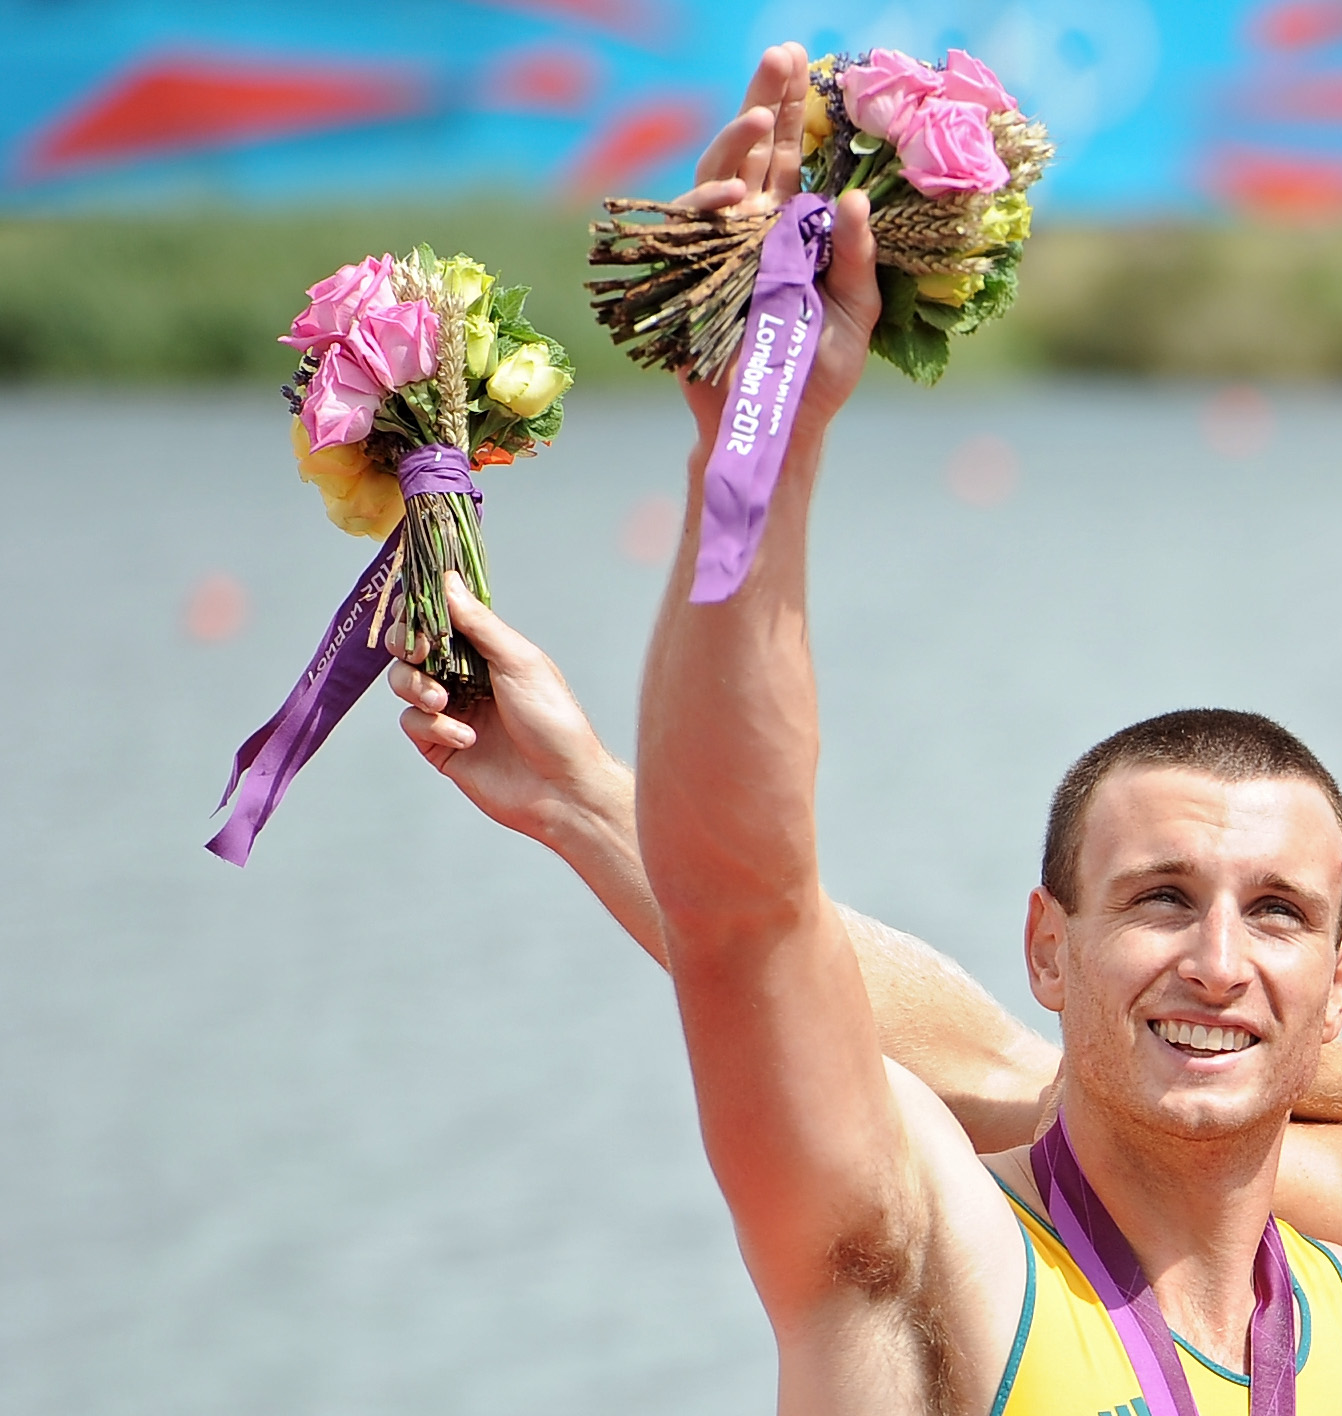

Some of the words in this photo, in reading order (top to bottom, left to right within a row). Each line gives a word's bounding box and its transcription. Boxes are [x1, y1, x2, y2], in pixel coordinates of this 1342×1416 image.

[740, 312, 785, 395] London
[726, 398, 762, 455] 2012
[308, 602, 363, 685] London
